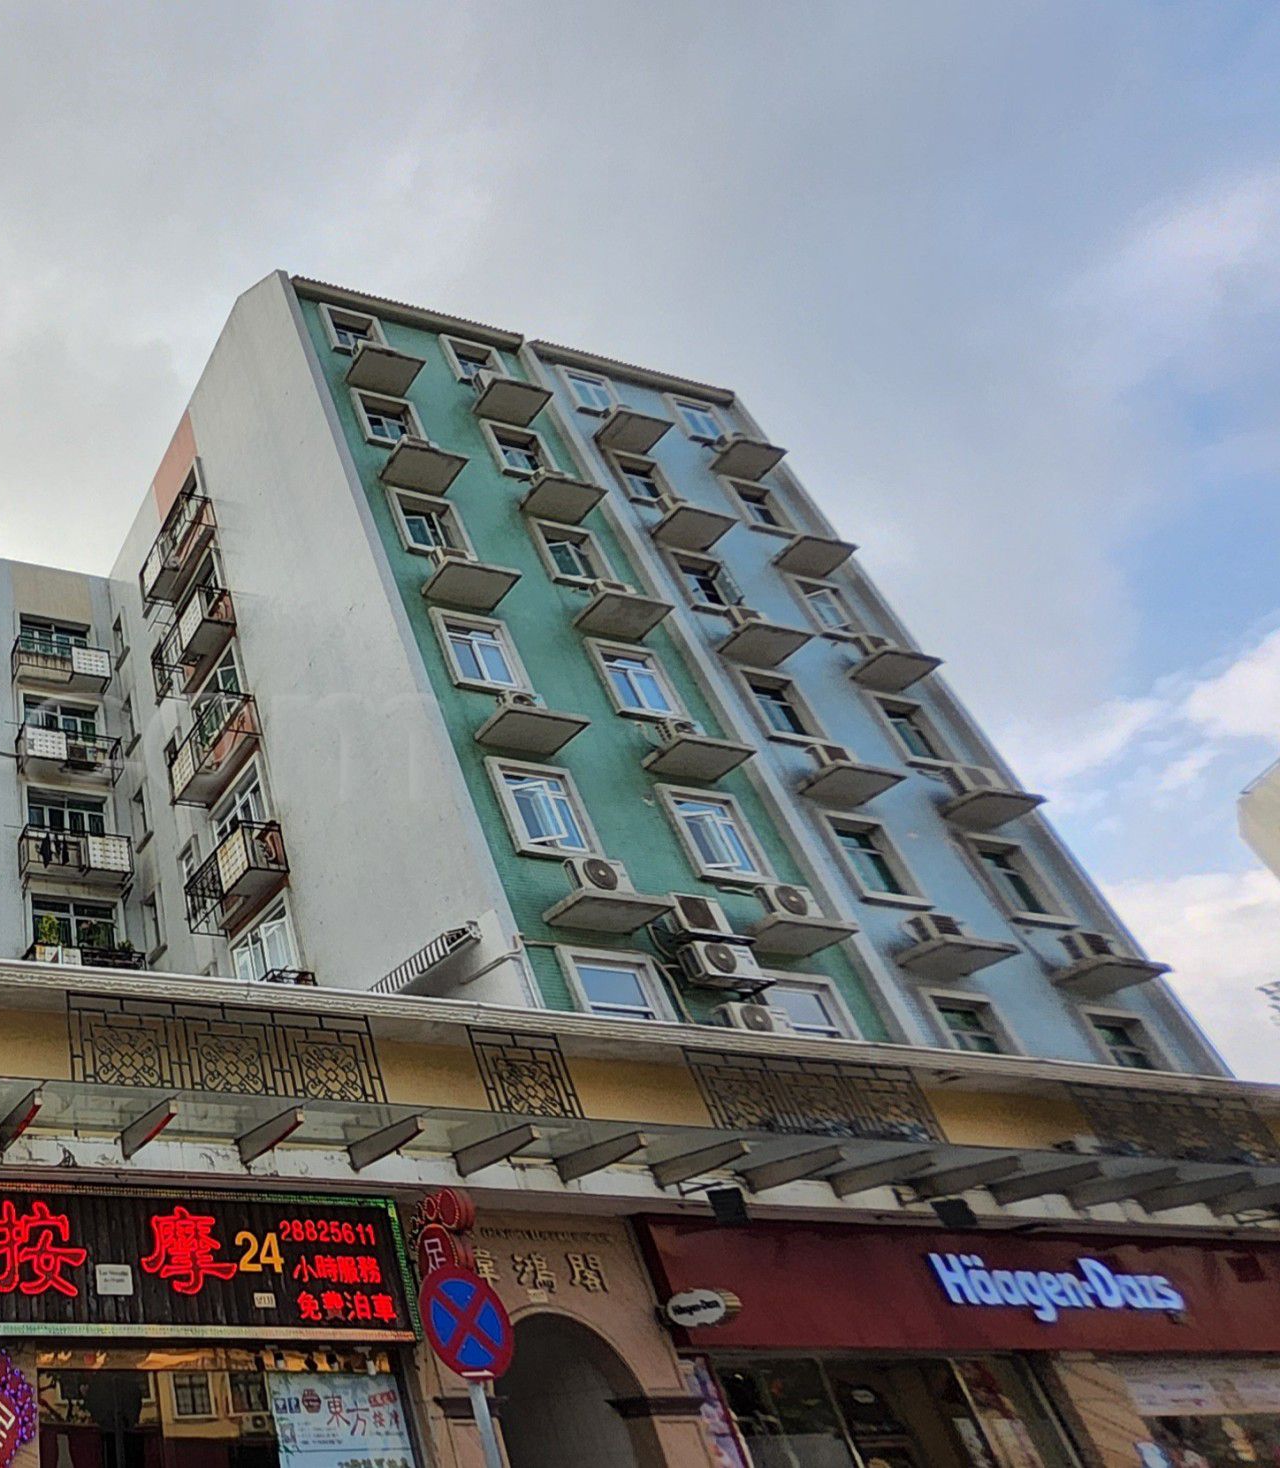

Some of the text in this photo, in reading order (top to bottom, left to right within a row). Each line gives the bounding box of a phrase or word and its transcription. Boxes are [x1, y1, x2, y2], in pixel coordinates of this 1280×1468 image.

[279, 1219, 376, 1247] 28825611
[235, 1231, 284, 1273] 24
[293, 1254, 382, 1284] 小時服務
[928, 1252, 1185, 1323] Häagen-Dazs
[297, 1290, 397, 1323] 免費泊車
